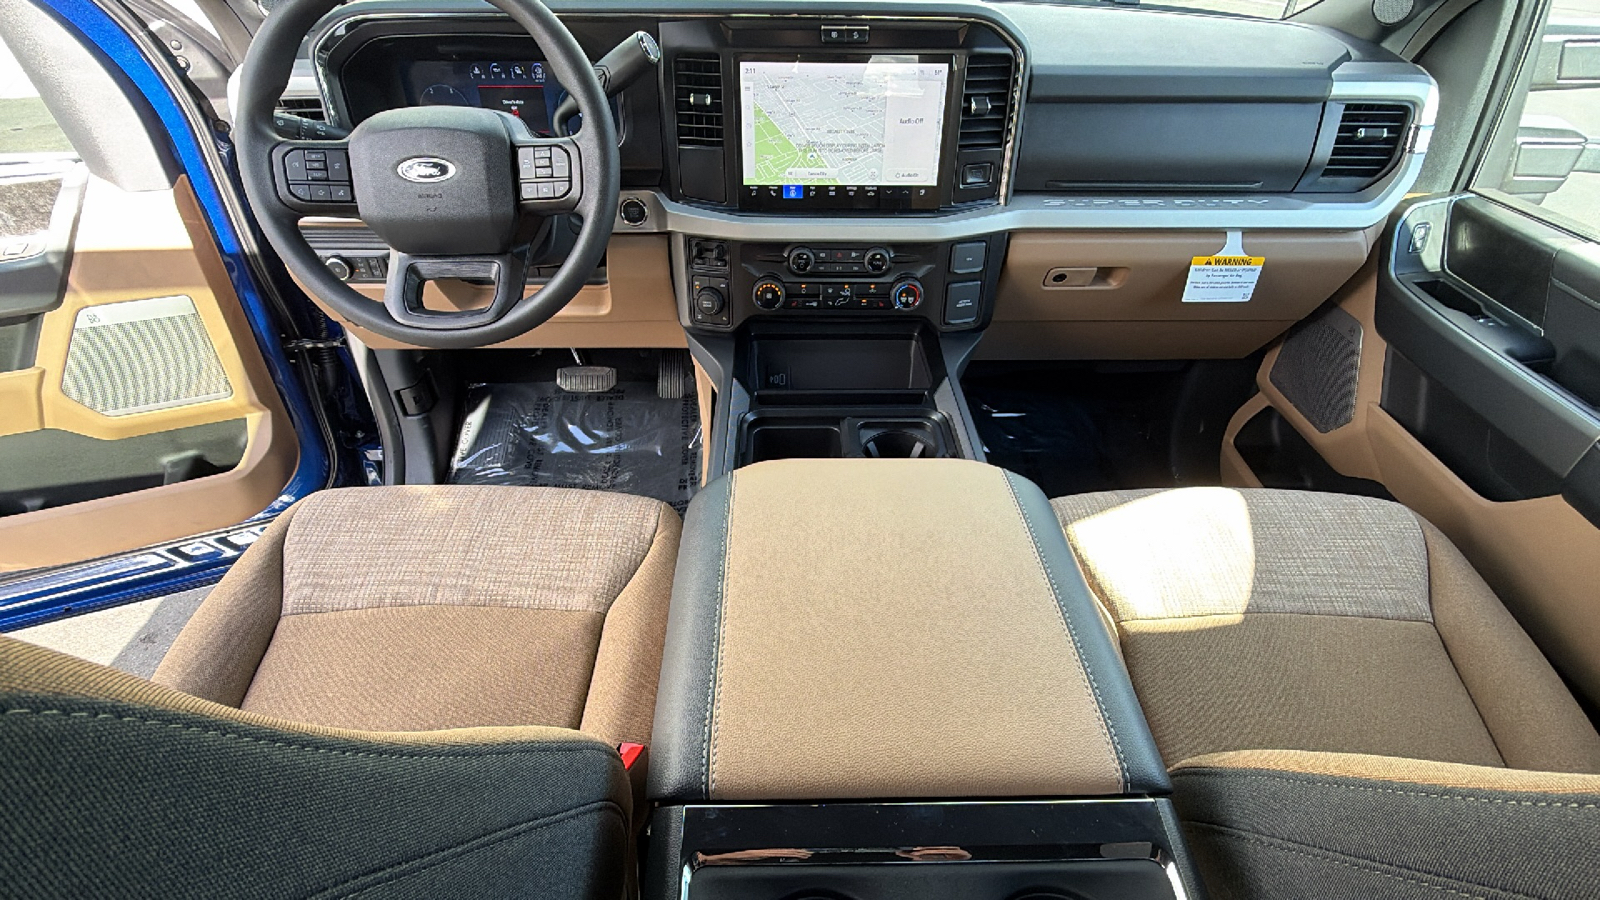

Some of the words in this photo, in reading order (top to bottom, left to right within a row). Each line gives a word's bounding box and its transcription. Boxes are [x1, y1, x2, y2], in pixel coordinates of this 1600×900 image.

[914, 117, 924, 125] Off
[1043, 199, 1166, 208] SUPER
[1174, 199, 1270, 208] DUTY
[1214, 257, 1253, 266] WARNING
[461, 421, 472, 445] COVER
